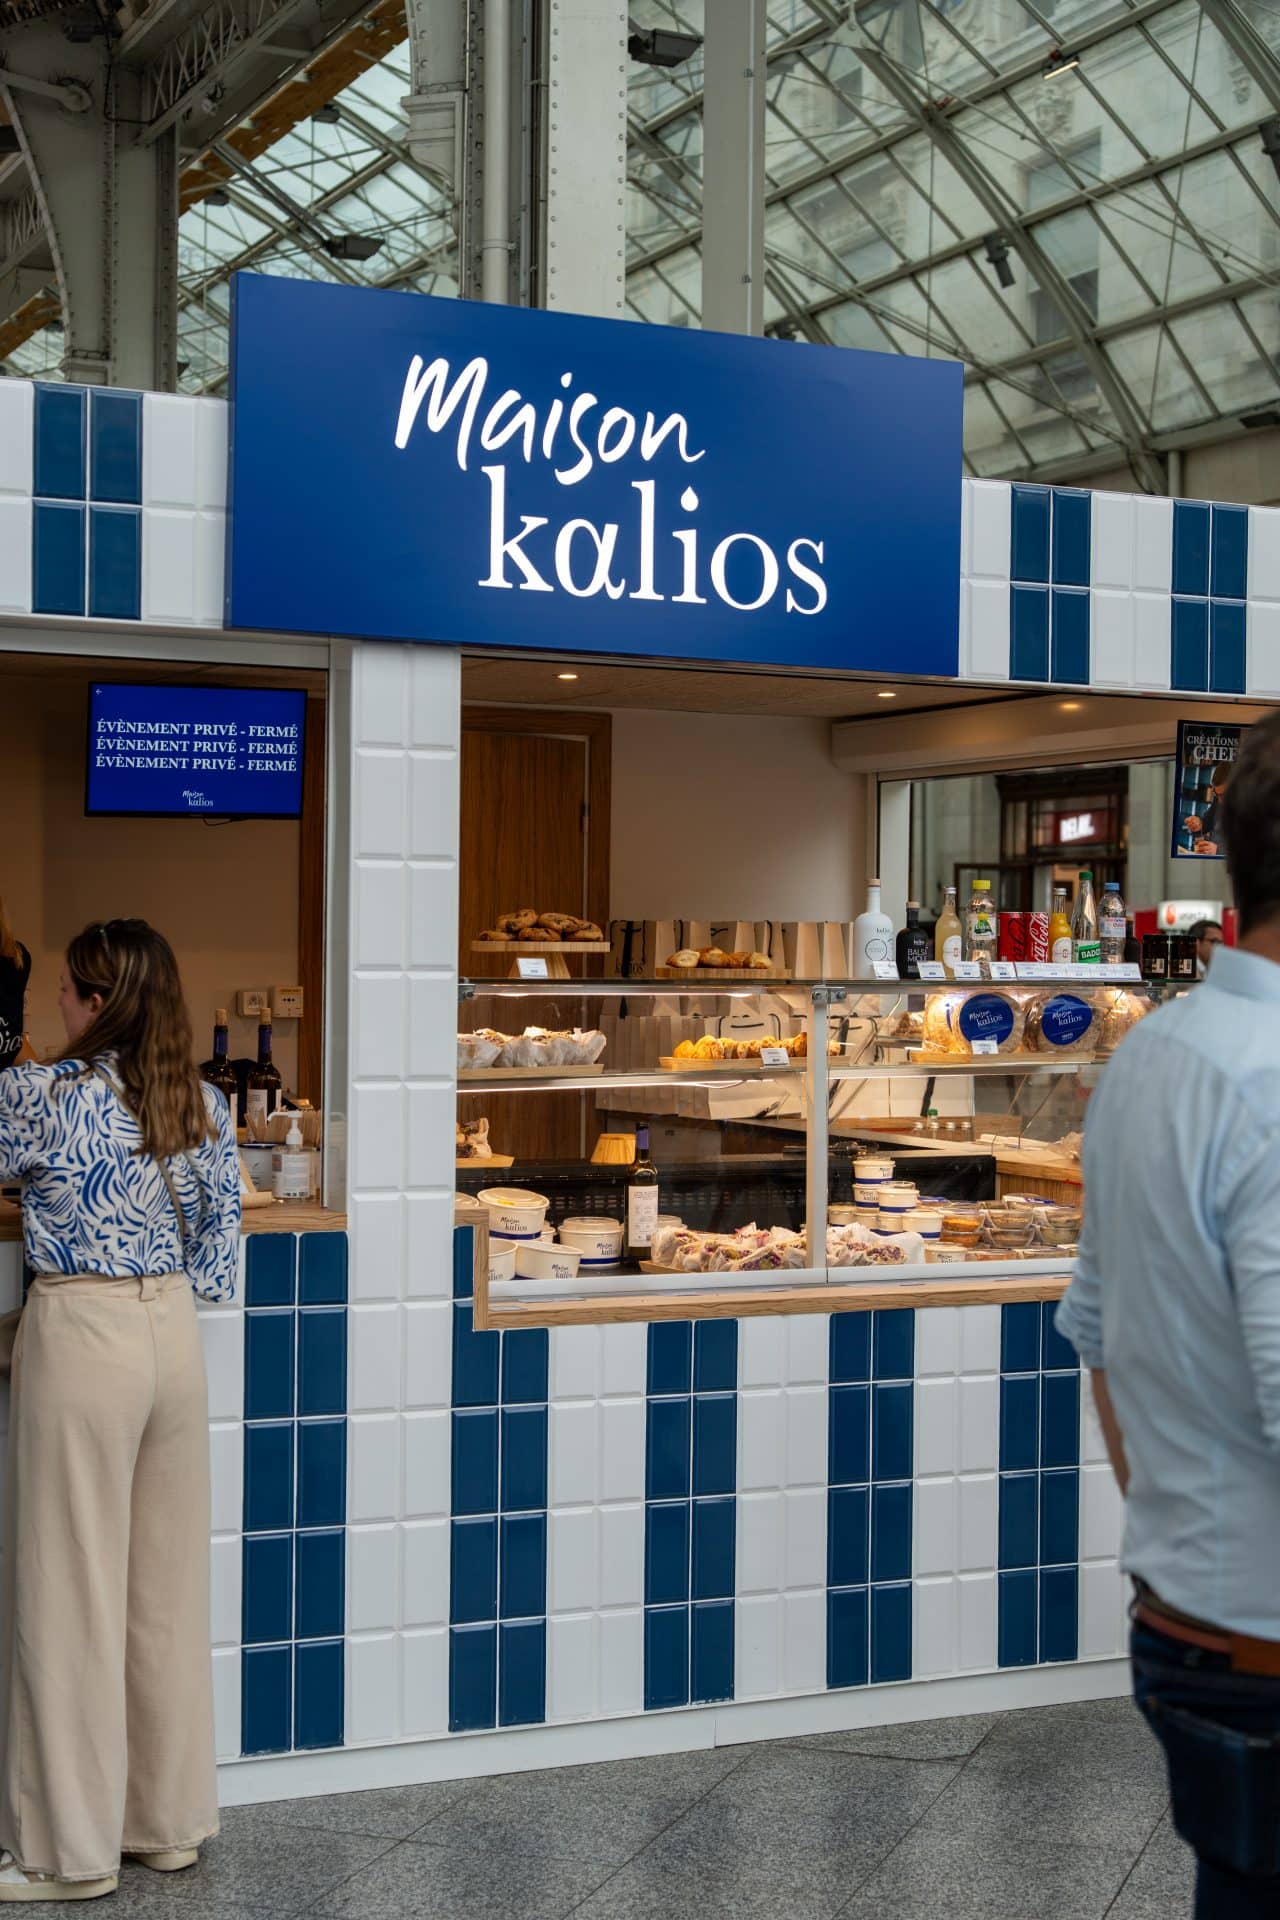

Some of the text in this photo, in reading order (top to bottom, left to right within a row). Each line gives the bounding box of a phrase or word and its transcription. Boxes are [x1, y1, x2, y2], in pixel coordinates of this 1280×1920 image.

[395, 354, 706, 486] Maison
[478, 465, 828, 615] kalios
[96, 718, 190, 734] ÉVÈNEMENT
[193, 722, 238, 736] PRIVÉ
[249, 724, 298, 738] FERMÉ
[96, 736, 190, 752] ÉVÈNEMENT
[192, 739, 237, 753] PRIVÉ
[247, 741, 298, 755] FERMÉ
[96, 753, 189, 769] ÉVÈNEMENT
[192, 757, 236, 770] PRIVÉ
[247, 758, 297, 772] FERMÉ
[188, 797, 213, 807] kalios
[977, 1014, 1003, 1028] kalios
[1058, 1013, 1082, 1026] kalios
